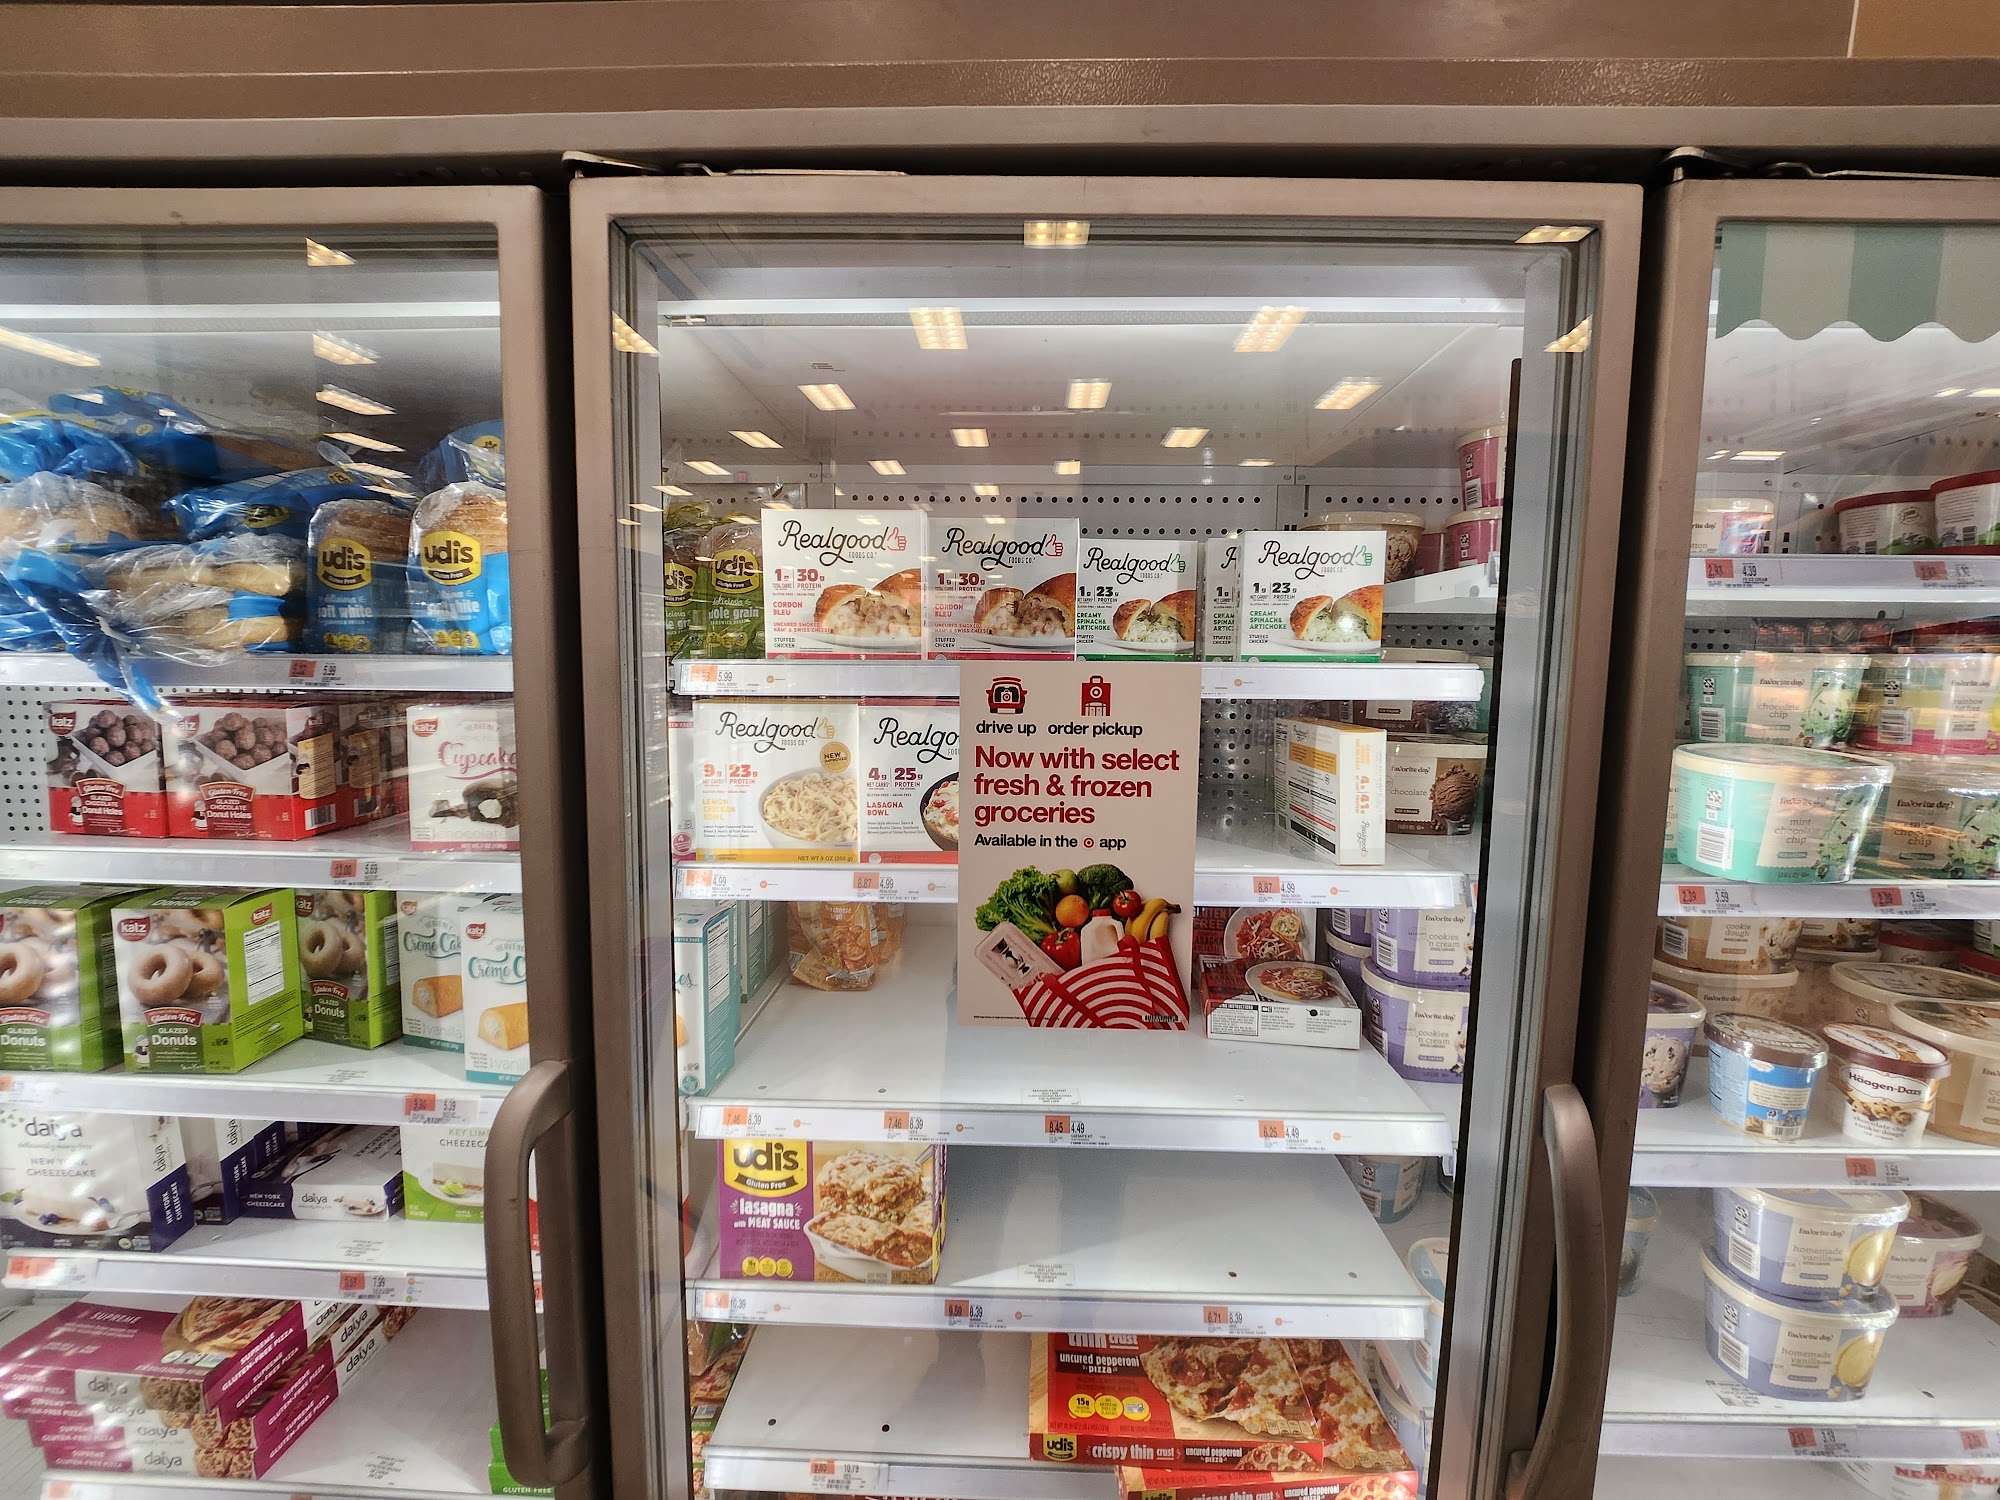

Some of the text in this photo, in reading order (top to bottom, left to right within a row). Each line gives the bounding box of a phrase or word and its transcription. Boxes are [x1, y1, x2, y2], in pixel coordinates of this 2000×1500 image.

[778, 520, 889, 567] Realgood
[942, 528, 1048, 571] Realgood
[424, 540, 474, 564] udis
[322, 547, 365, 571] udis
[1258, 540, 1358, 580] Realgood
[1083, 548, 1172, 585] Realgood
[733, 608, 759, 621] grain
[718, 672, 733, 682] 5.99
[1758, 703, 1800, 712] chocolate
[1769, 710, 1788, 720] chip
[52, 717, 73, 727] katz
[414, 722, 437, 733] katz
[715, 711, 819, 754] Realgood
[976, 720, 1037, 737] drive up
[1048, 722, 1143, 738] order pickup
[874, 716, 959, 764] Realgo
[975, 746, 1180, 771] Now with select
[1391, 765, 1418, 774] favorite
[974, 773, 1152, 798] fresh & frozen
[1390, 788, 1428, 797] chocolate
[82, 806, 123, 816] Donut Holes
[207, 810, 252, 820] Donut Holes
[974, 801, 1096, 827] groceries
[1790, 818, 1811, 827] mint
[1774, 826, 1821, 836] chocolate
[974, 834, 1127, 850] Available in the app
[1786, 834, 1807, 846] chip
[1908, 837, 1932, 847] chip
[712, 876, 727, 887] 4.99
[858, 878, 872, 889] 8.87
[880, 879, 894, 889] 4.99
[1258, 883, 1272, 893] 8.87
[1281, 883, 1295, 894] 4.99
[1715, 891, 1729, 903] 3.59
[254, 908, 271, 922] katz
[1425, 915, 1452, 923] favorite
[121, 922, 147, 935] katz
[1725, 929, 1750, 939] dough
[1429, 933, 1459, 941] cookies
[314, 1004, 345, 1019] Donuts
[1415, 1012, 1442, 1020] favorite
[1418, 1030, 1449, 1038] cookies
[0, 1034, 46, 1048] Donuts
[152, 1034, 197, 1047] Donuts
[1849, 1071, 1923, 1097] Häagen-Dazs
[748, 1115, 762, 1126] 8.39
[888, 1118, 902, 1129] 7.46
[910, 1119, 924, 1130] 8.39
[1853, 1116, 1891, 1130] chocolate
[449, 1128, 466, 1137] KEY
[1049, 1122, 1064, 1133] 8.45
[1071, 1123, 1085, 1134] 4.49
[1264, 1126, 1278, 1138] 6.25
[1286, 1128, 1300, 1139] 4.49
[1855, 1122, 1905, 1140] cookie dough
[439, 1138, 488, 1149] CHEEZECA
[733, 1142, 799, 1172] udis
[26, 1168, 97, 1178] CHEEZECAKE
[746, 1178, 787, 1189] Gluten Free
[301, 1193, 328, 1205] daiya
[739, 1198, 794, 1218] lasagna
[734, 1216, 801, 1231] with MEAT SAUCE
[1793, 1246, 1843, 1255] homemade
[90, 1311, 143, 1325] SUPREME
[1208, 1312, 1221, 1324] 6.71
[1229, 1313, 1243, 1324] 8.39
[341, 1309, 369, 1343] daiya
[240, 1332, 276, 1366] SUPREME
[346, 1337, 376, 1373] daiya
[1782, 1347, 1832, 1359] homemade
[222, 1327, 294, 1391] GLUTEN-FREE PIZZA
[1060, 1353, 1140, 1367] uncured pepperoni
[252, 1352, 284, 1384] SUPREME
[309, 1364, 326, 1383] PIZZA
[1088, 1366, 1112, 1374] pizza
[236, 1347, 300, 1409] GLUTEN-FREE PIZZA
[1076, 1398, 1090, 1407] 15g
[285, 1400, 315, 1434] SUPREME
[270, 1394, 331, 1459] GLUTEN-FREE PIZZA
[1046, 1439, 1074, 1453] udis
[1092, 1444, 1174, 1460] crispy thin crust
[1185, 1447, 1243, 1459] uncured pepperoni
[144, 1451, 183, 1469] daiya
[502, 1486, 552, 1494] GLUTEN-FREE
[1284, 1484, 1340, 1497] uncured pepperoni
